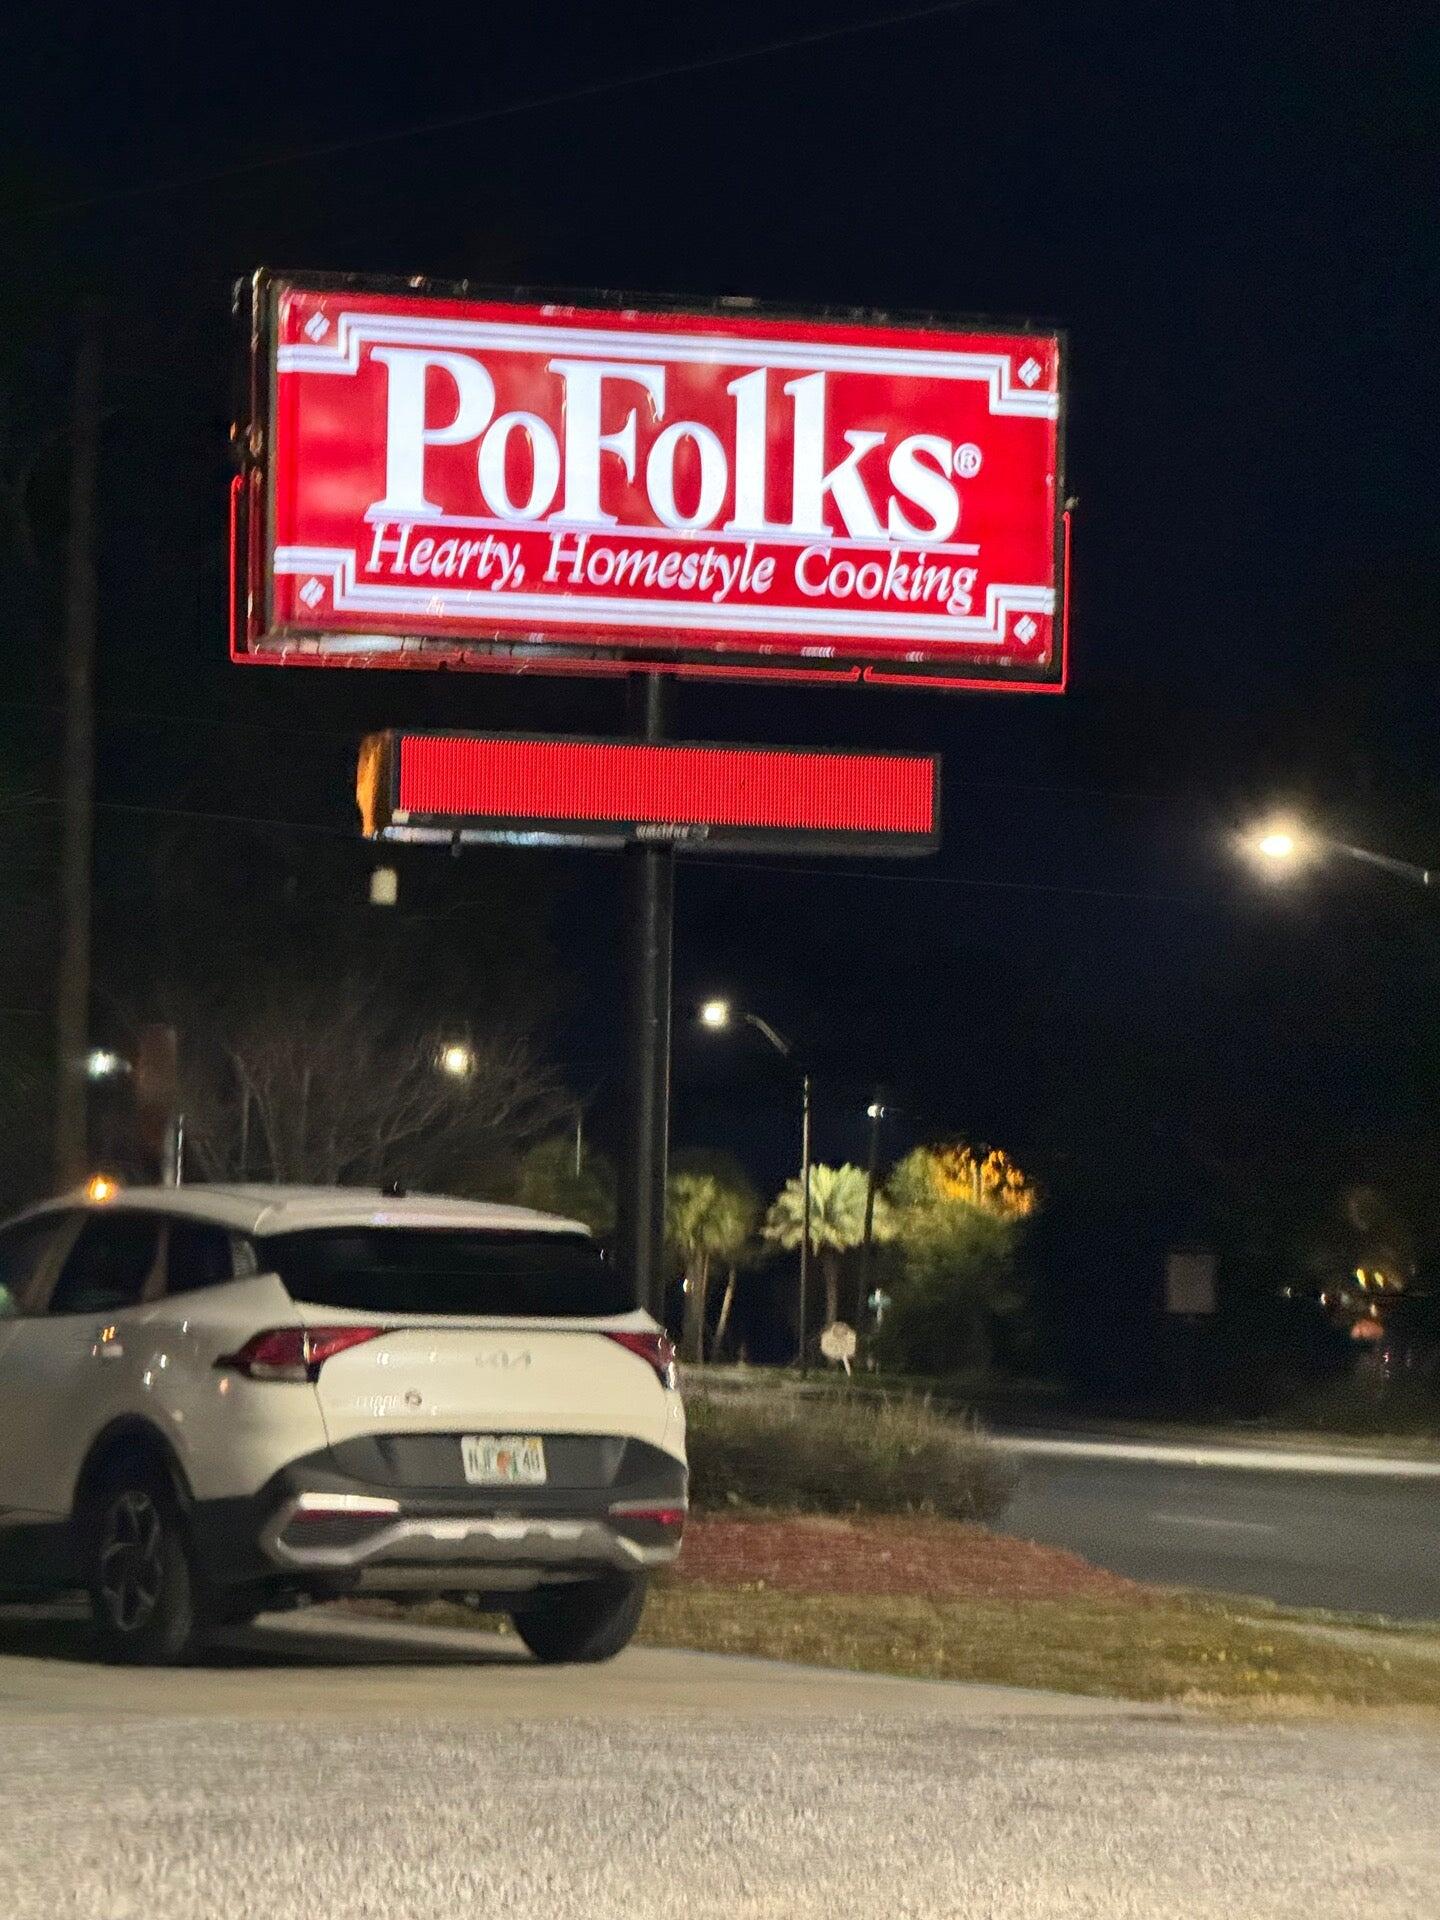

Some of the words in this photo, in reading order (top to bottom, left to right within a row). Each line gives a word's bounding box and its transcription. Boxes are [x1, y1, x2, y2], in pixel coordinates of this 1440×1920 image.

[364, 521, 525, 592] Hearty,
[542, 532, 776, 603] Homestyle
[794, 543, 979, 616] Cooking
